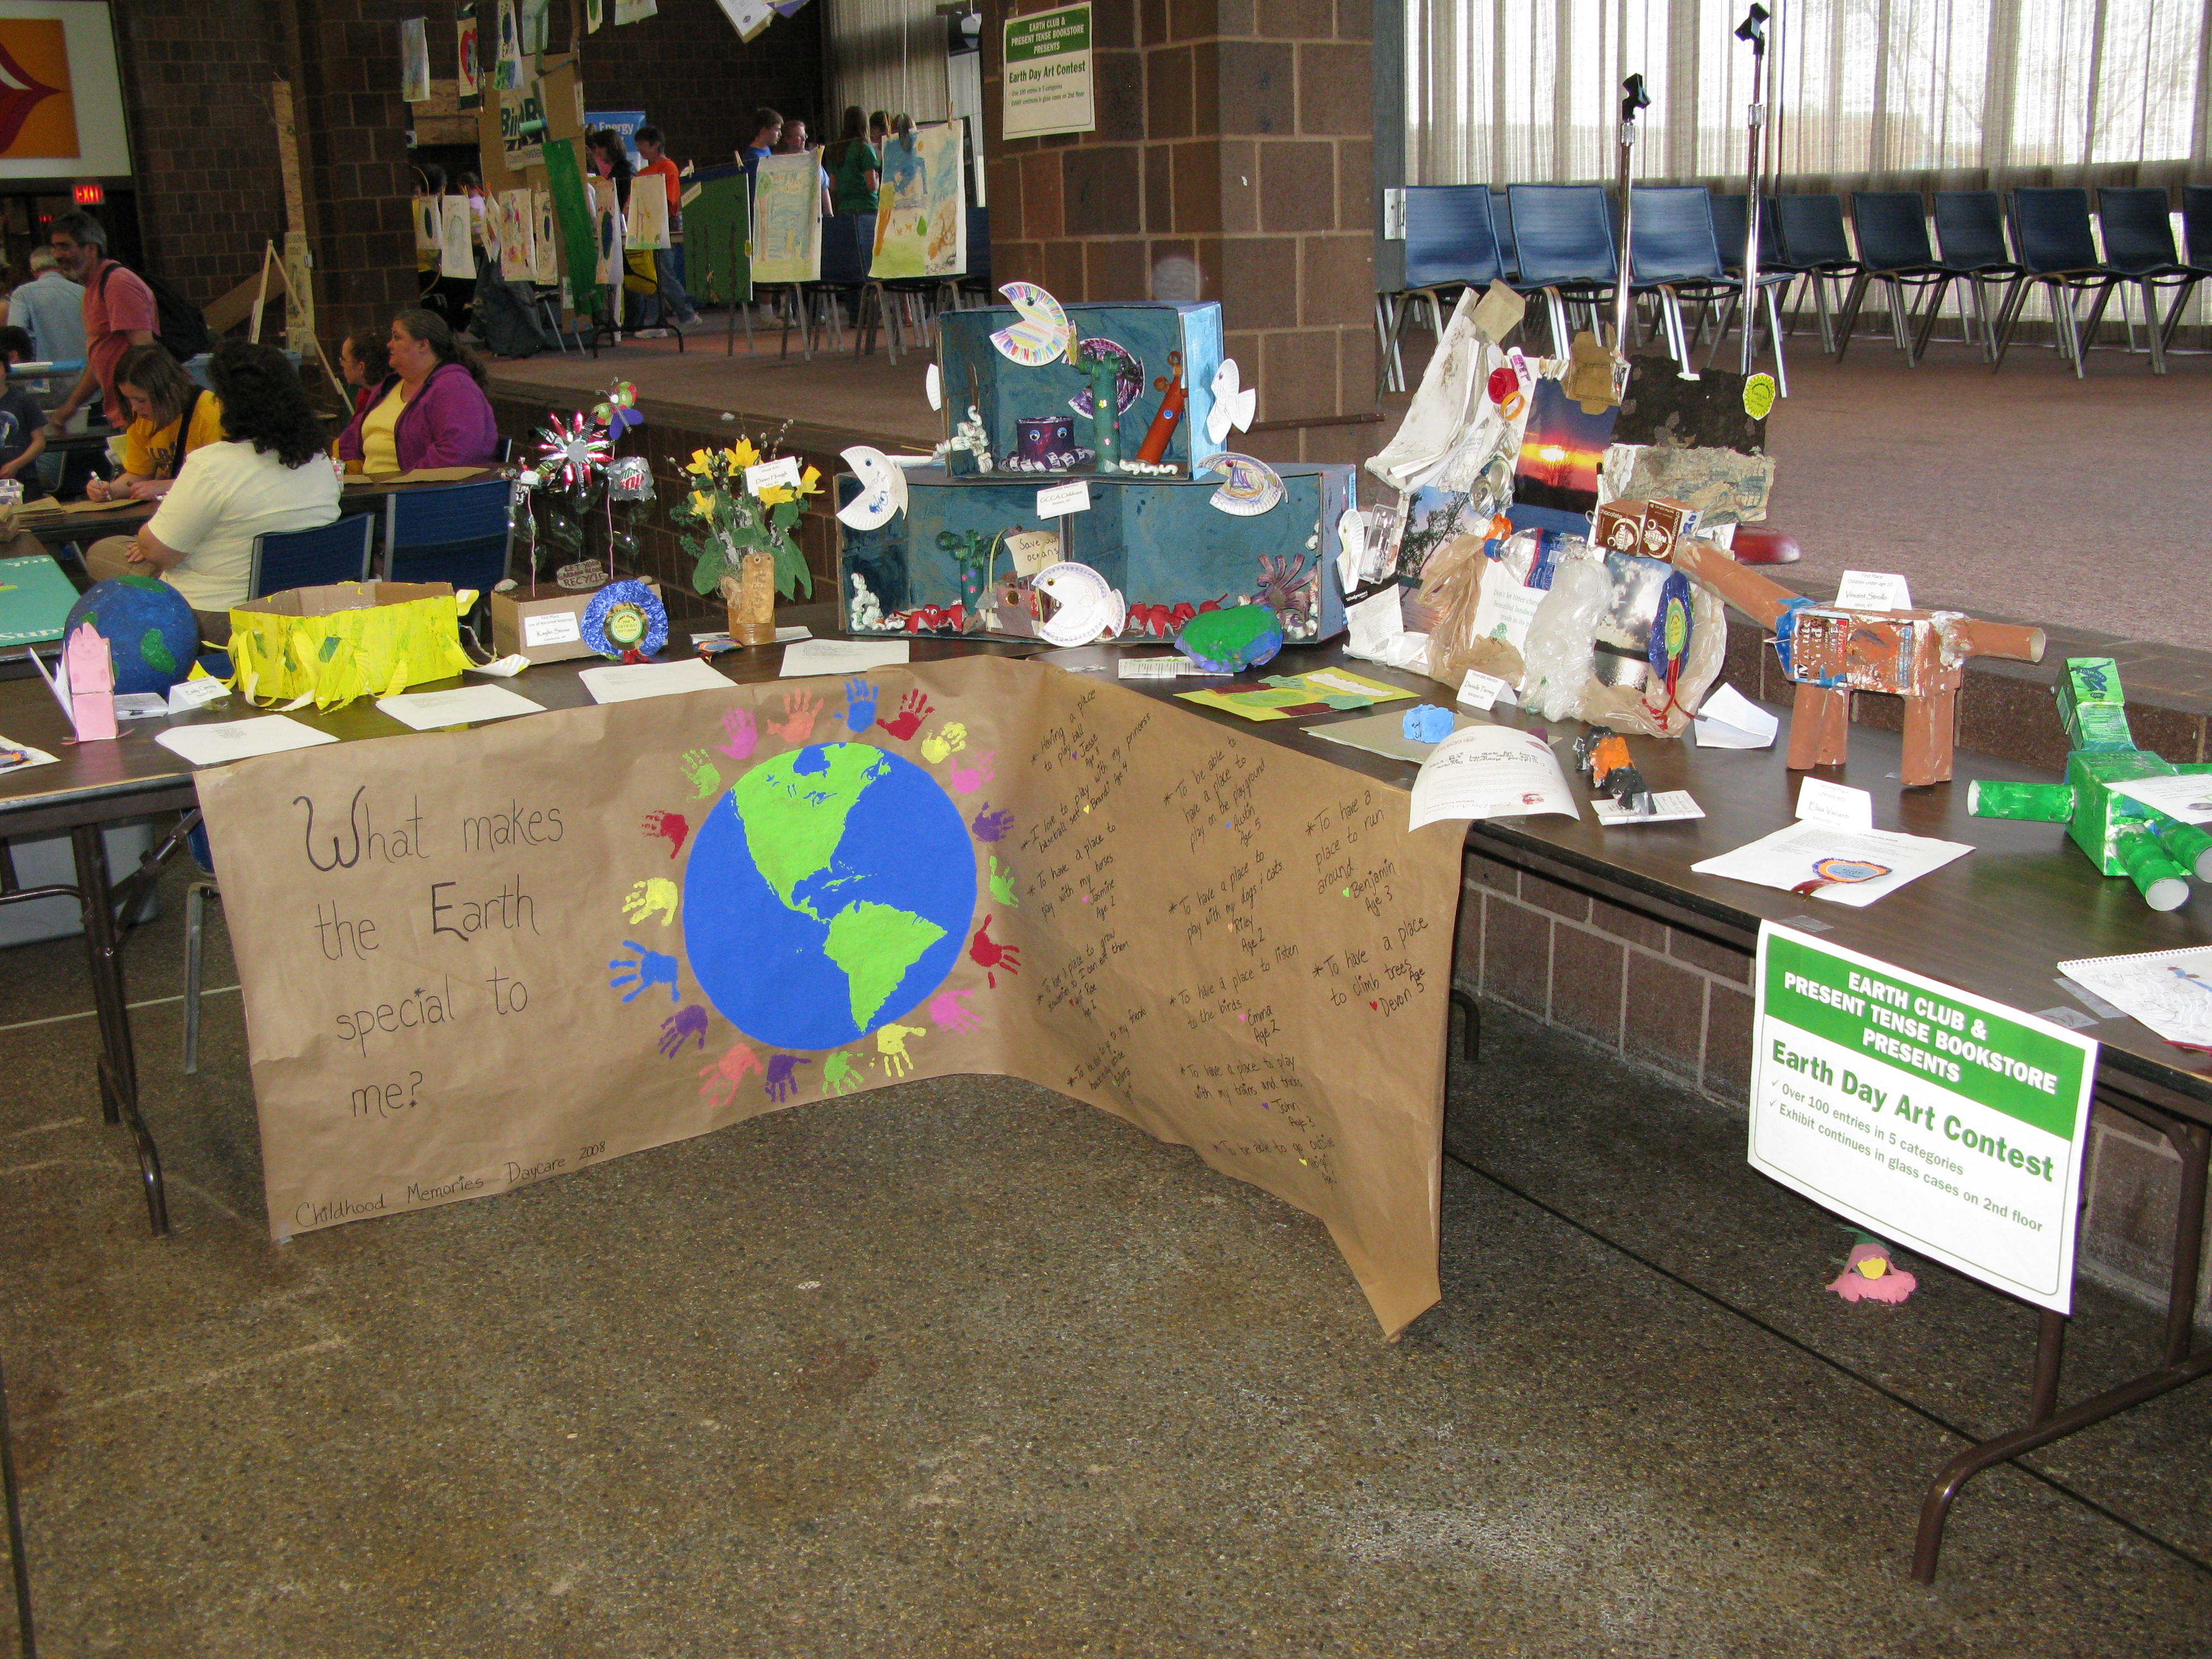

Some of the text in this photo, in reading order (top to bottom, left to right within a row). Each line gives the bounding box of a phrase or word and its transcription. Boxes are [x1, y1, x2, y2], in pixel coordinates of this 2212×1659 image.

[1011, 24, 1084, 46] PRESENT TENSE BOOKSTORE
[1029, 17, 1066, 32] EARTH CLUB &
[1034, 41, 1061, 54] PRESENTS
[1009, 60, 1086, 83] Earth Day Art Contest
[75, 187, 100, 203] EXIT
[1600, 509, 1623, 518] chocolate
[1671, 512, 1681, 540] chocolate
[1020, 539, 1040, 550] Save
[563, 573, 605, 587] RECYCLE
[1513, 594, 1526, 602] litter
[1041, 690, 1095, 753] Having place
[1057, 744, 1072, 768] play
[1074, 712, 1151, 810] play with princess
[1079, 733, 1098, 758] Jesse
[1176, 736, 1236, 799] To be able to
[1182, 753, 1246, 824] have place to
[1190, 757, 1265, 854] play playground
[1234, 802, 1255, 832] Austin
[1314, 790, 1371, 833] To have a
[293, 785, 564, 872] What makes
[1039, 823, 1067, 853] baseball
[1315, 808, 1385, 873] place to run
[1051, 834, 1104, 880] have place
[1079, 874, 1091, 894] my
[1179, 849, 1264, 915] To have place to
[1350, 859, 1396, 898] Benjamin
[1187, 884, 1256, 946] play with dogs
[1365, 885, 1392, 917] Age 3
[315, 875, 540, 961] the Earth
[1234, 915, 1254, 934] Riley
[1241, 927, 1264, 956] Age 2
[1324, 916, 1428, 977] To have a place
[1178, 944, 1298, 1005] To have place to listen
[1409, 967, 1426, 982] Age
[1331, 975, 1380, 1006] to climb
[1380, 988, 1412, 1017] Devon
[1849, 971, 1987, 1041] EARTH CLUB &
[337, 966, 529, 1058] special to
[1200, 999, 1242, 1023] the birds
[1248, 1005, 1273, 1026] Emma
[1254, 1020, 1280, 1046] Age 2
[1785, 971, 2058, 1095] PRESENT TENSE BOOKSTORE
[1204, 1053, 1295, 1080] have place play
[1863, 1027, 1961, 1082] PRESENTS
[351, 1071, 424, 1118] me?
[1194, 1077, 1277, 1100] with and
[1772, 1039, 2053, 1182] Earth Day Art Contest
[1782, 1083, 1963, 1175] Over 100 entries in 5 categories
[1780, 1103, 2043, 1232] Exhibit continues in glass cases on 2nd floor
[295, 1141, 607, 1229] Childhood Memories Daycare 2008
